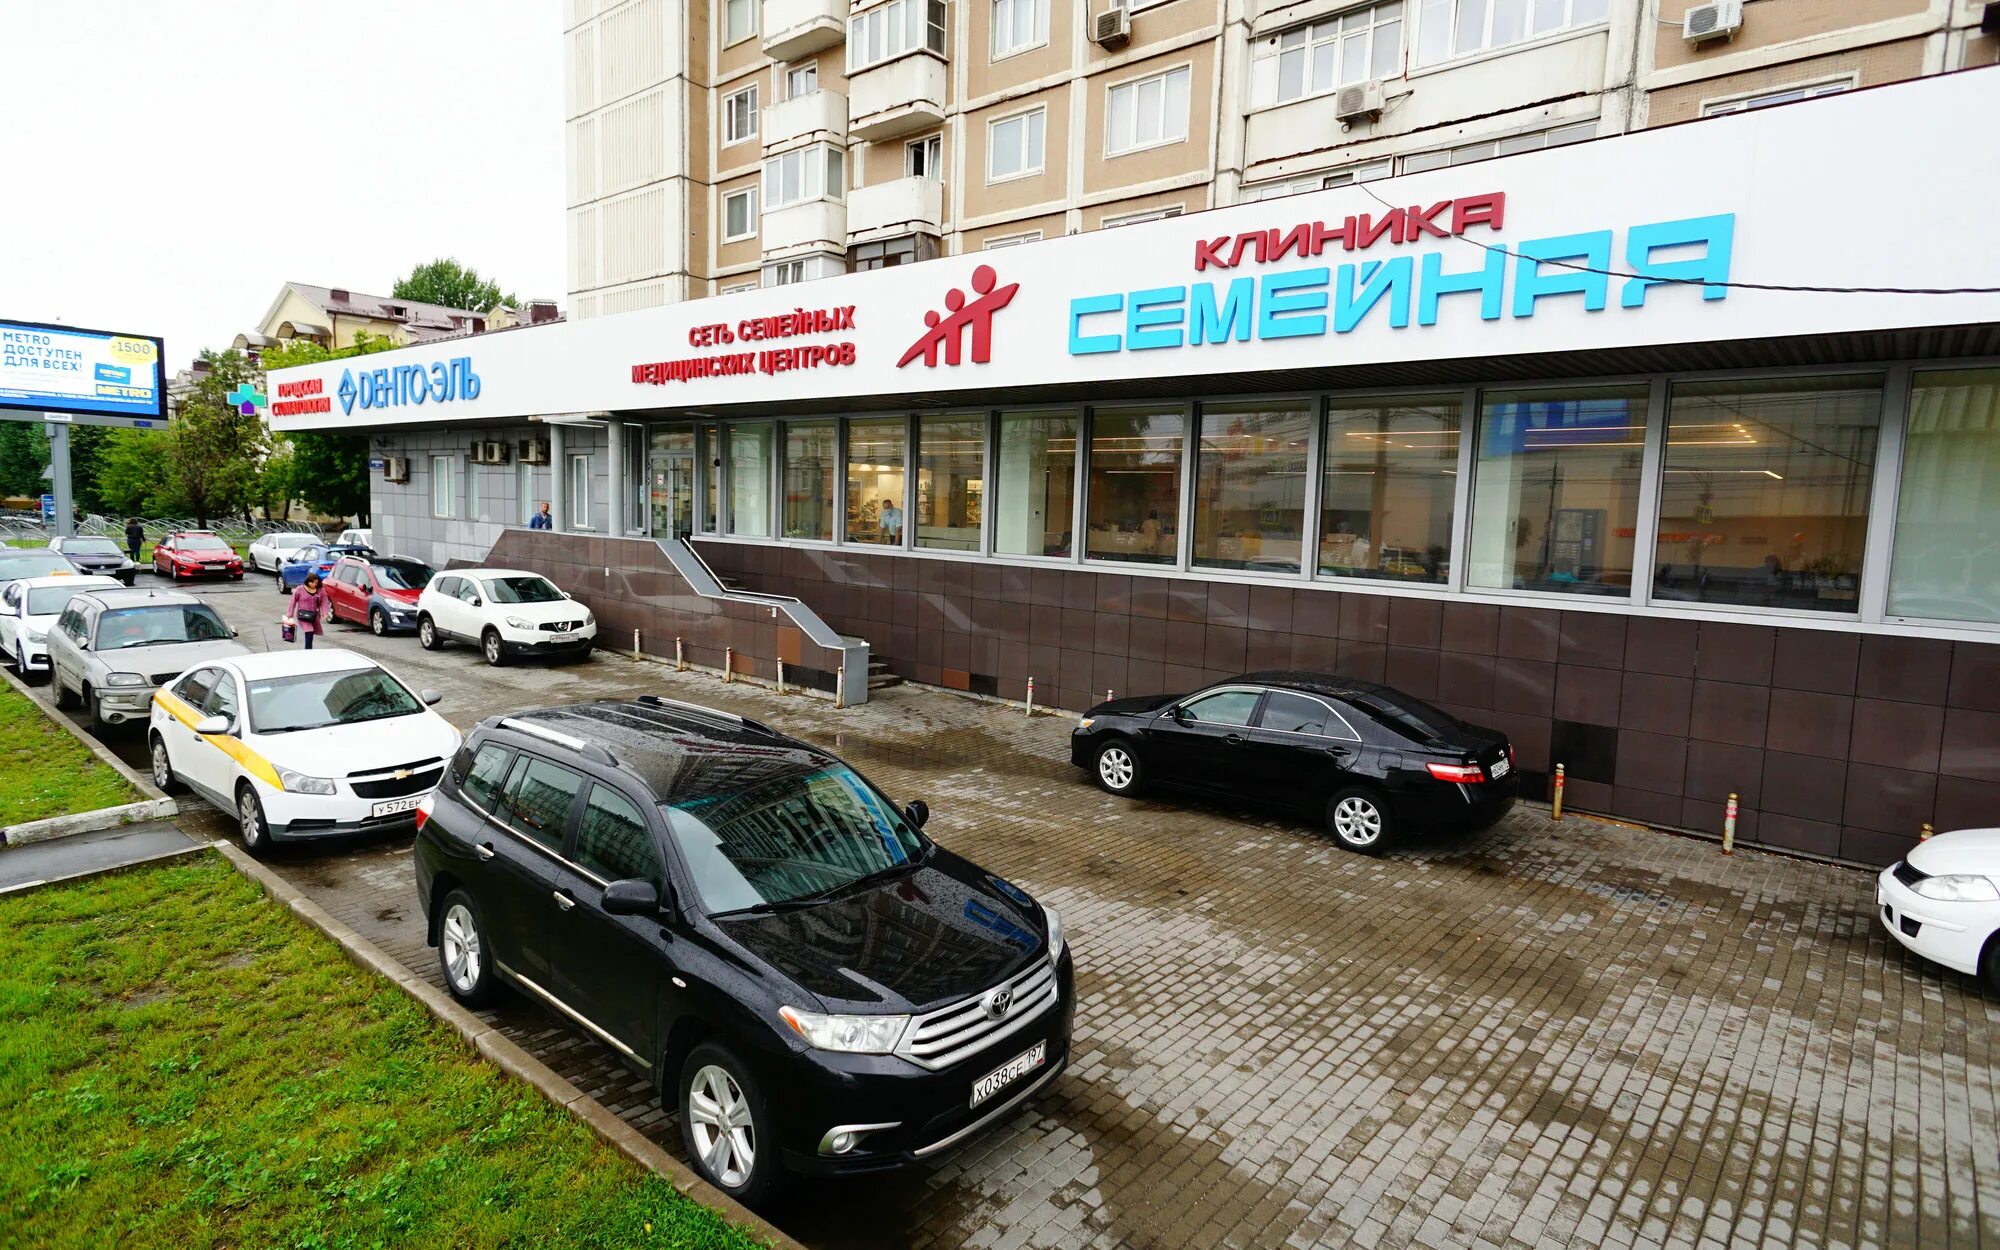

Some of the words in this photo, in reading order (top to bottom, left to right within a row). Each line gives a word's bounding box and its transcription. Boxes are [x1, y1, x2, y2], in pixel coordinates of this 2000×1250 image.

[1195, 192, 1506, 271] КЛИНИКА
[1068, 212, 1737, 356] СЕМЕЙНАЯ
[3, 332, 51, 345] METRO
[688, 323, 735, 348] СЕТЬ
[737, 304, 856, 342] СЕМЕЙНЫХ
[3, 344, 82, 360] ДОСТУПЕН
[4, 356, 39, 368] ДЛЯ
[631, 351, 756, 386] МЕДИЦИНСКИХ
[758, 341, 857, 376] ЦЕНТРОВ
[976, 1061, 1023, 1102] Х038СЕ
